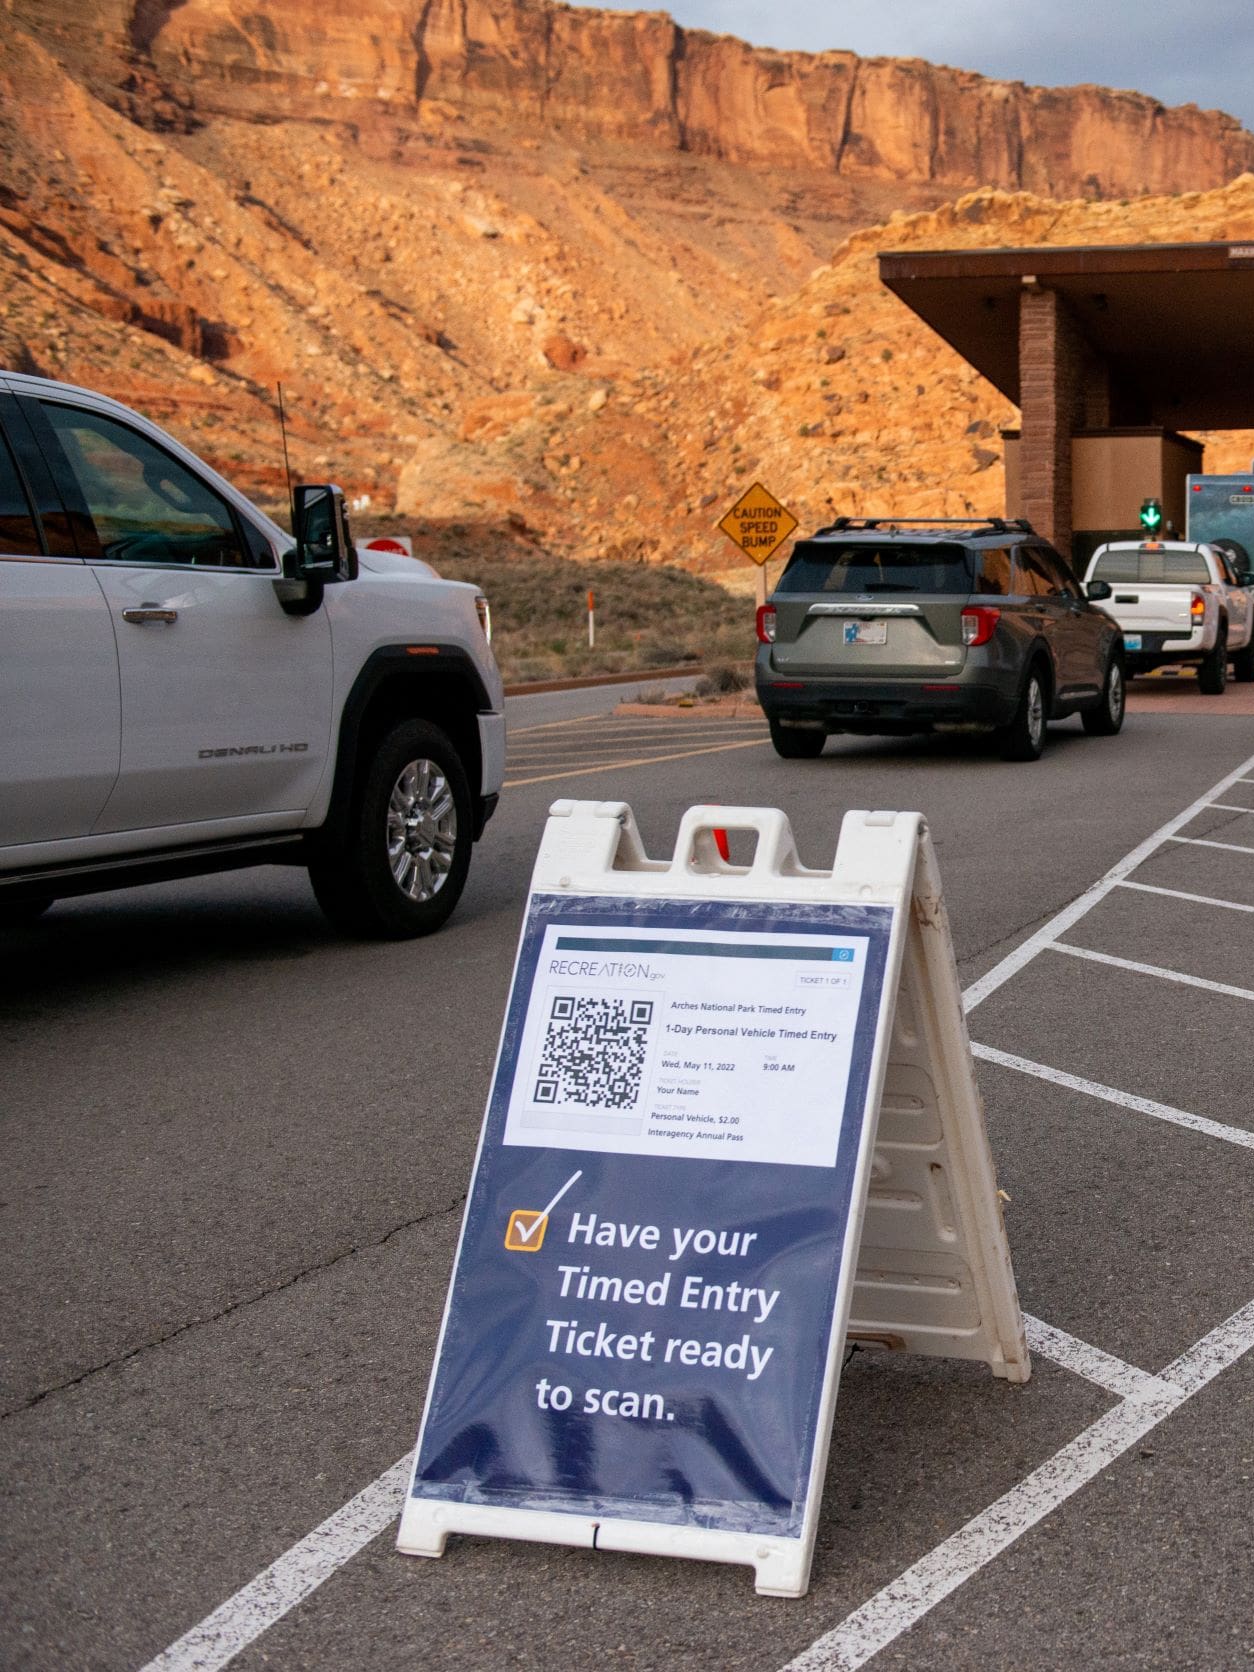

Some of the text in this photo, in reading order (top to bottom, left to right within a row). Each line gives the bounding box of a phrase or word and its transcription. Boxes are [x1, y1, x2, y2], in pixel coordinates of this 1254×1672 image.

[733, 507, 782, 519] CAUTION
[740, 521, 778, 533] SPEED
[741, 535, 776, 548] BUMP
[198, 743, 308, 759] DENALI HD
[800, 976, 824, 985] TICKET
[831, 977, 841, 985] OF
[671, 1001, 807, 1016] Arches National Park Timed Entry
[665, 1024, 838, 1042] 1-Day Personal Vehicle Timed Entry
[661, 1060, 735, 1071] Wed, May 11, 2022
[762, 1063, 796, 1072] 9:00 AM
[657, 1086, 700, 1096] Your Name
[651, 1112, 740, 1125] Personal Vehicle, $2.00
[647, 1128, 744, 1142] Interagency Annual Pass
[568, 1212, 757, 1261] Have your
[558, 1265, 780, 1323] Timed Entry
[546, 1319, 774, 1380] Ticket ready
[535, 1378, 675, 1421] to scan.
